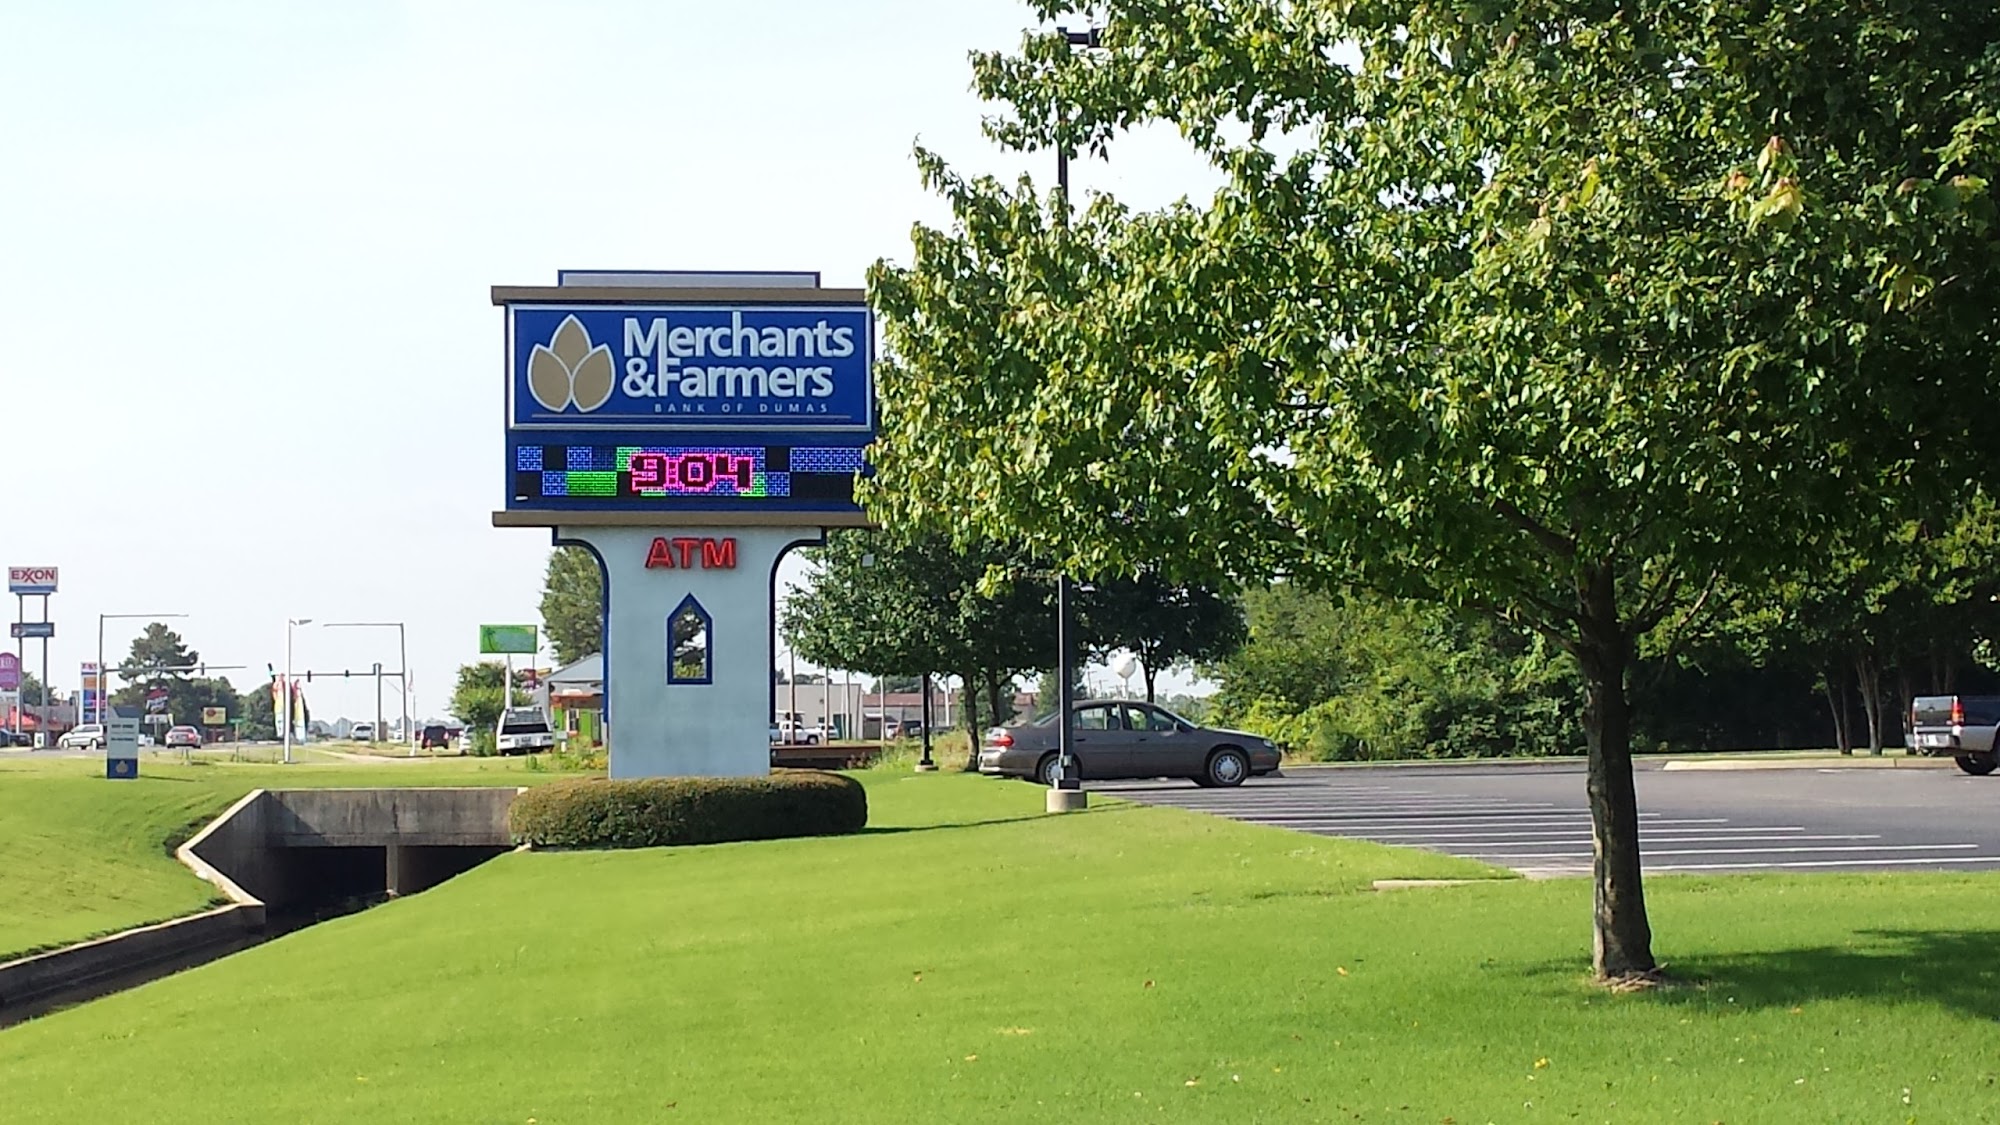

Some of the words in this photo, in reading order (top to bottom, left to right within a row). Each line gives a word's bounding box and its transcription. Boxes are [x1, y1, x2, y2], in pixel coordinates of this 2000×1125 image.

[623, 311, 855, 358] Merchants
[654, 403, 705, 413] BANK
[721, 403, 744, 413] OF
[759, 403, 828, 413] DUMAS
[631, 454, 752, 491] 9:04
[645, 537, 737, 569] ATM
[11, 568, 55, 584] EXXON
